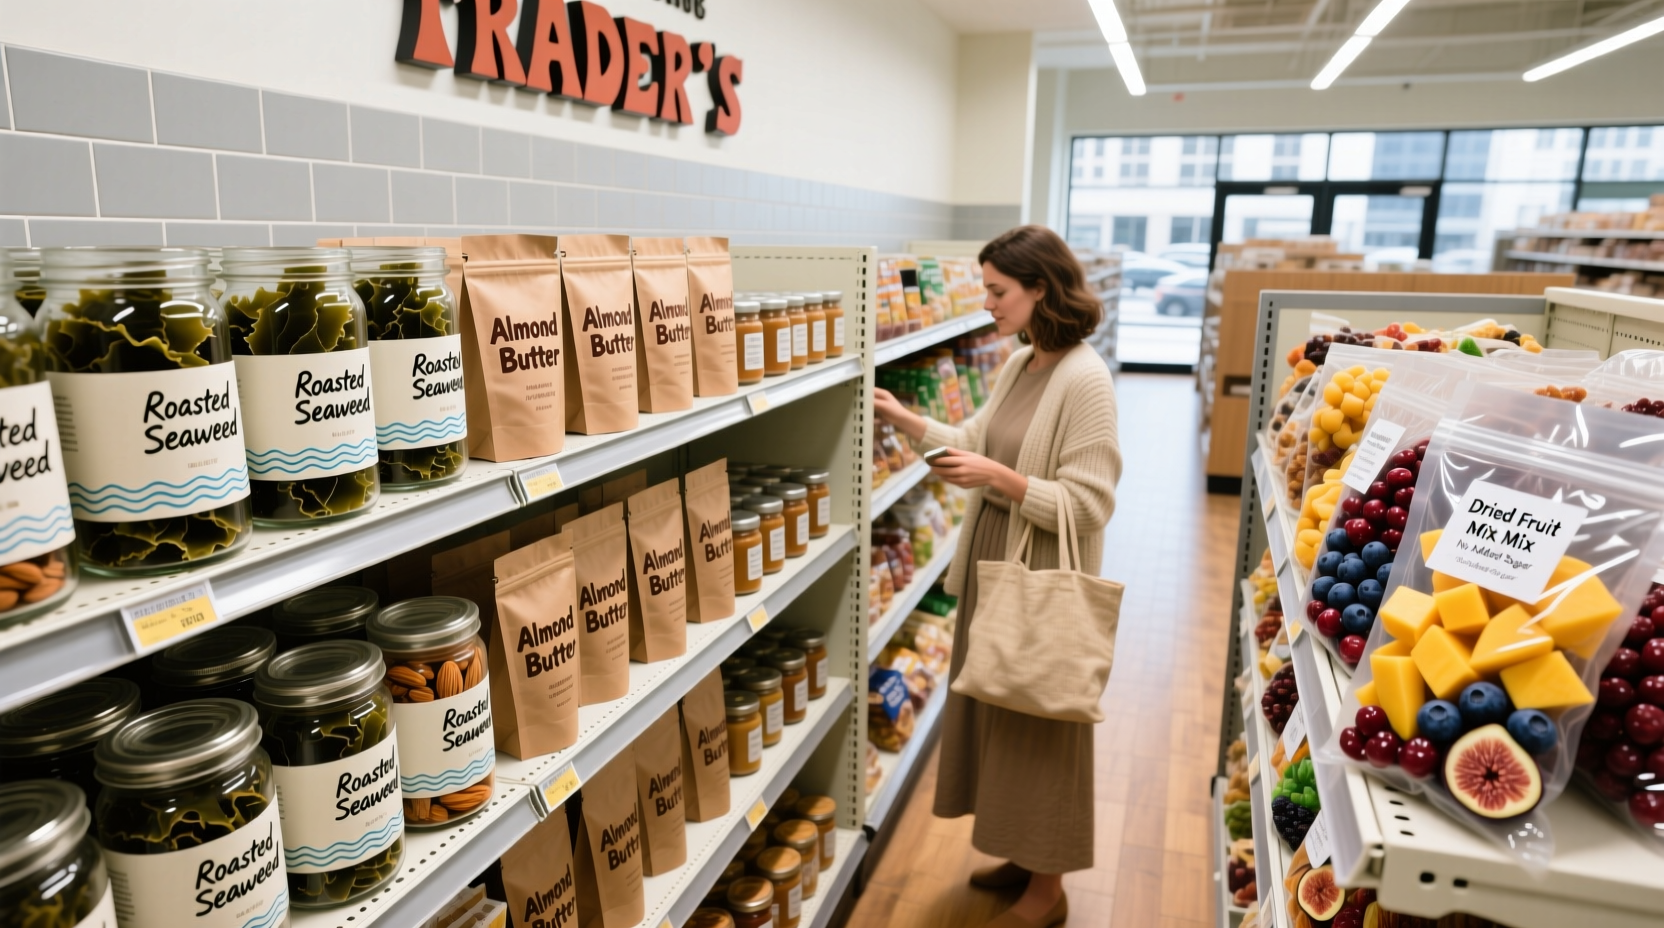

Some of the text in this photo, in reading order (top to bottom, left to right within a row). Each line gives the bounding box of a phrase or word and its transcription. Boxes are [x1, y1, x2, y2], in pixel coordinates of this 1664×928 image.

[490, 312, 558, 345] Almond
[582, 303, 632, 332] Almond
[499, 347, 560, 374] Butter
[590, 333, 635, 358] Butter
[295, 364, 365, 398] Roasted
[143, 380, 230, 423] Roasted
[294, 386, 371, 425] Seaweed
[144, 407, 238, 455] Seaweed
[1466, 520, 1536, 553] Mix Mix
[1468, 498, 1562, 537] Dried Fruit
[643, 538, 683, 575] Almond
[580, 568, 626, 611] Almond
[517, 605, 574, 653] Almond
[525, 639, 576, 678] Butter
[336, 744, 395, 799] Roasted
[335, 764, 398, 821] Seaweed
[196, 821, 273, 890] Roasted
[195, 841, 280, 917] Seaweed
[524, 863, 573, 922] Almond
